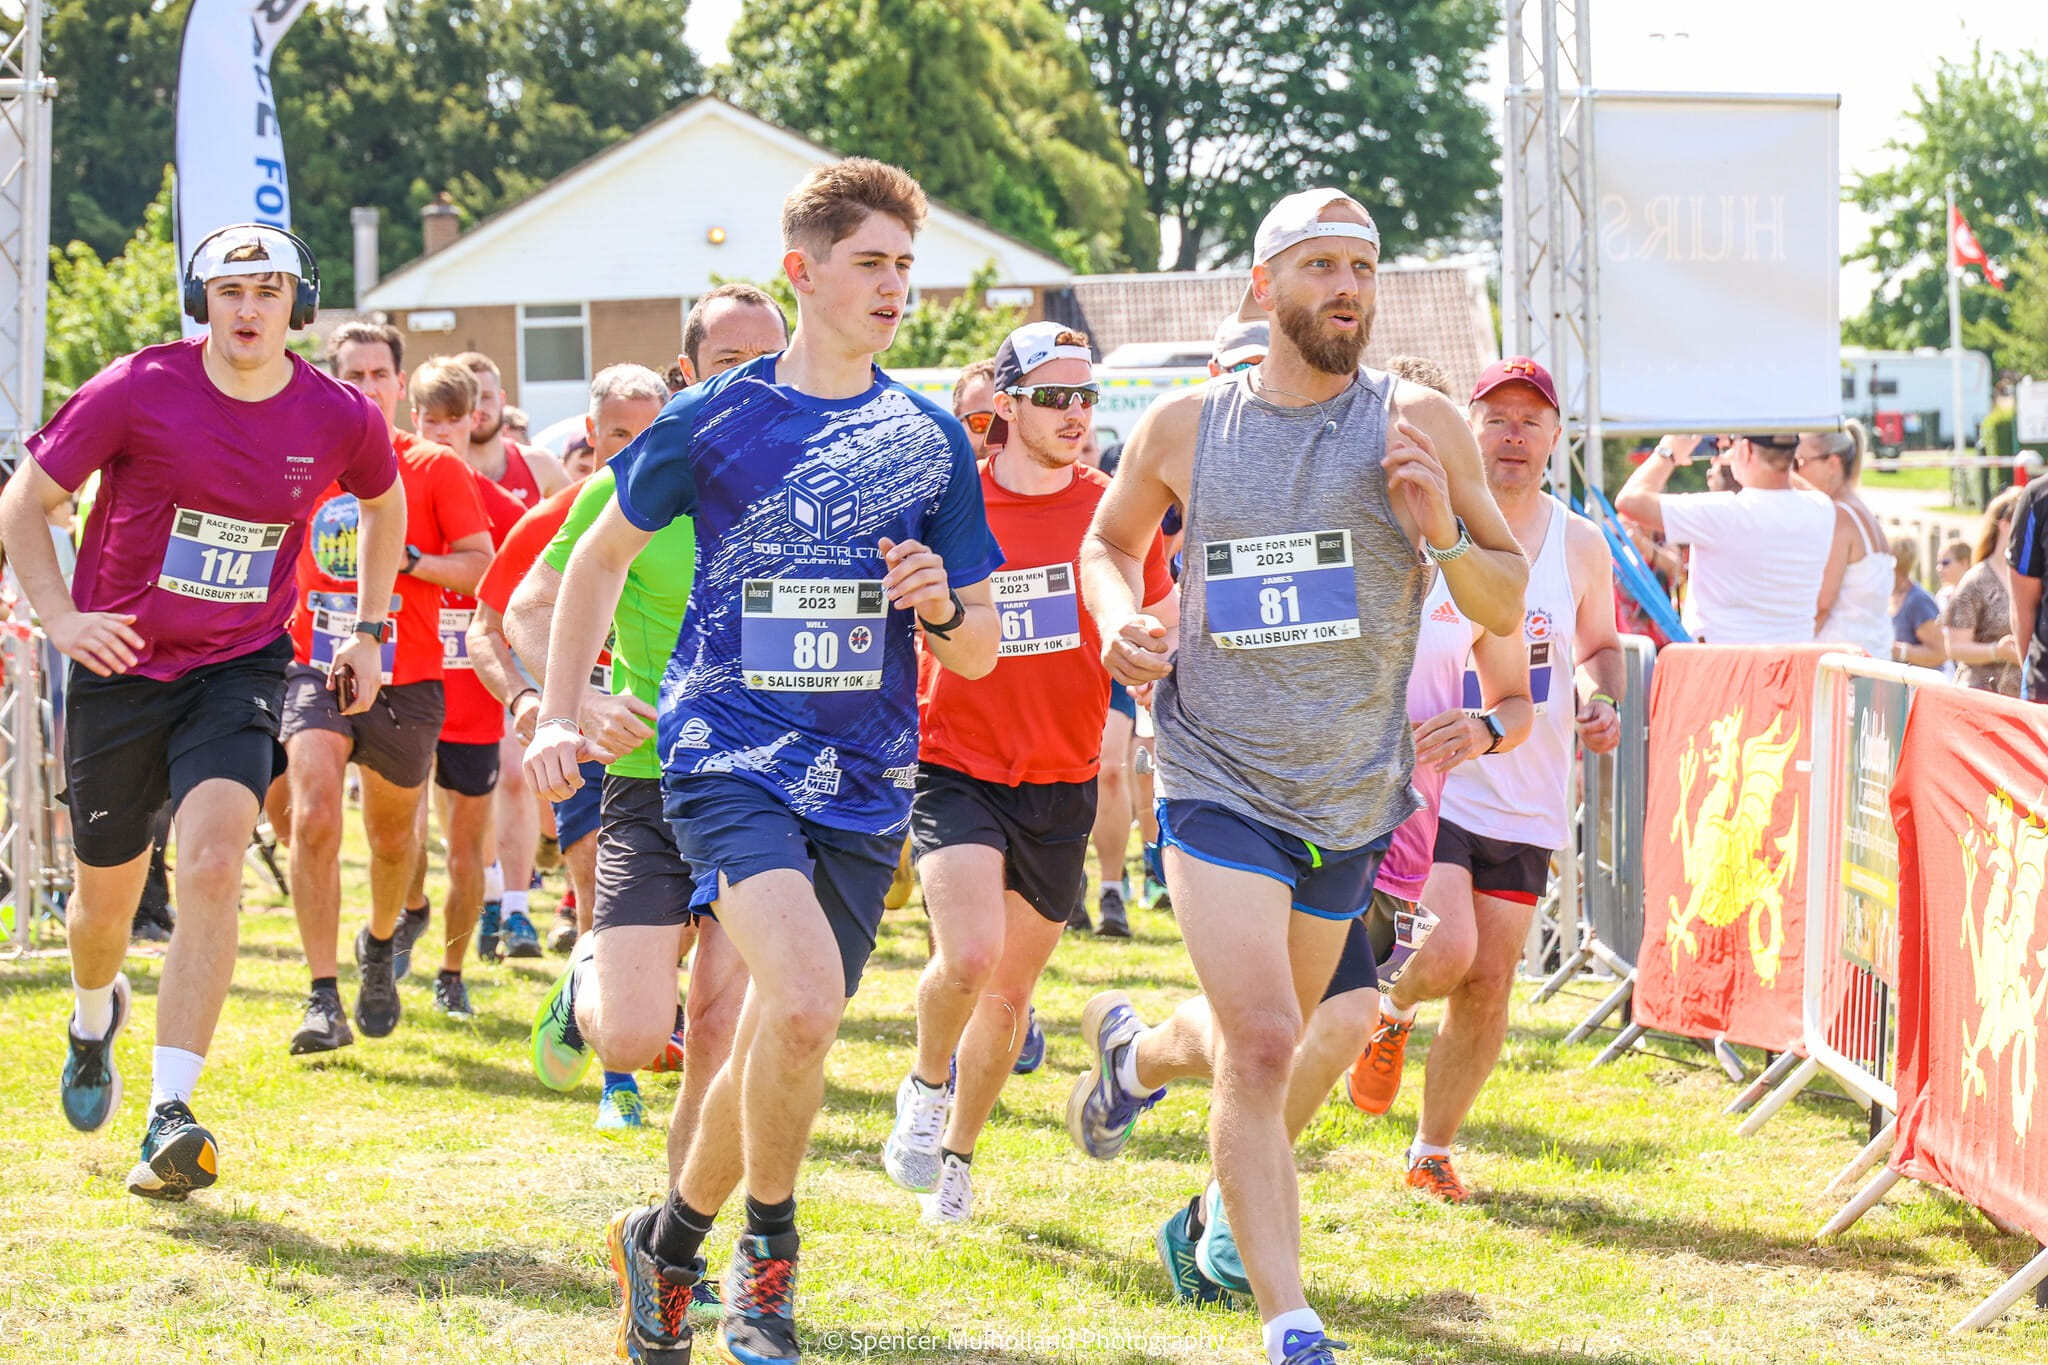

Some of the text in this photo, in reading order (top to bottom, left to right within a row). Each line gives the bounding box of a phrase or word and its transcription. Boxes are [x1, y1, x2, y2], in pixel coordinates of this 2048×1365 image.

[255, 156, 284, 230] FO
[206, 519, 264, 535] RACE FOR MEN
[218, 531, 249, 544] 2023
[1236, 538, 1312, 553] RACE FOR MEN
[1256, 552, 1294, 566] 2023
[200, 548, 252, 586] 114
[1026, 572, 1044, 580] MEN
[1261, 575, 1293, 585] JAMES
[181, 584, 255, 600] SALISBURY 10K
[779, 585, 855, 594] RACE FOR MEN
[999, 583, 1030, 594] 2023
[798, 597, 836, 609] 2023
[1003, 601, 1029, 609] HARRY
[1259, 585, 1301, 626] 81
[1001, 609, 1035, 640] 61
[1431, 614, 1459, 624] adidas
[1235, 625, 1338, 647] SALISBURY 10K
[792, 631, 839, 670] 80
[1044, 639, 1063, 650] 10K
[768, 675, 840, 688] SALISBURY
[843, 675, 864, 687] 10K
[810, 768, 839, 779] RACE
[808, 780, 836, 793] MEN
